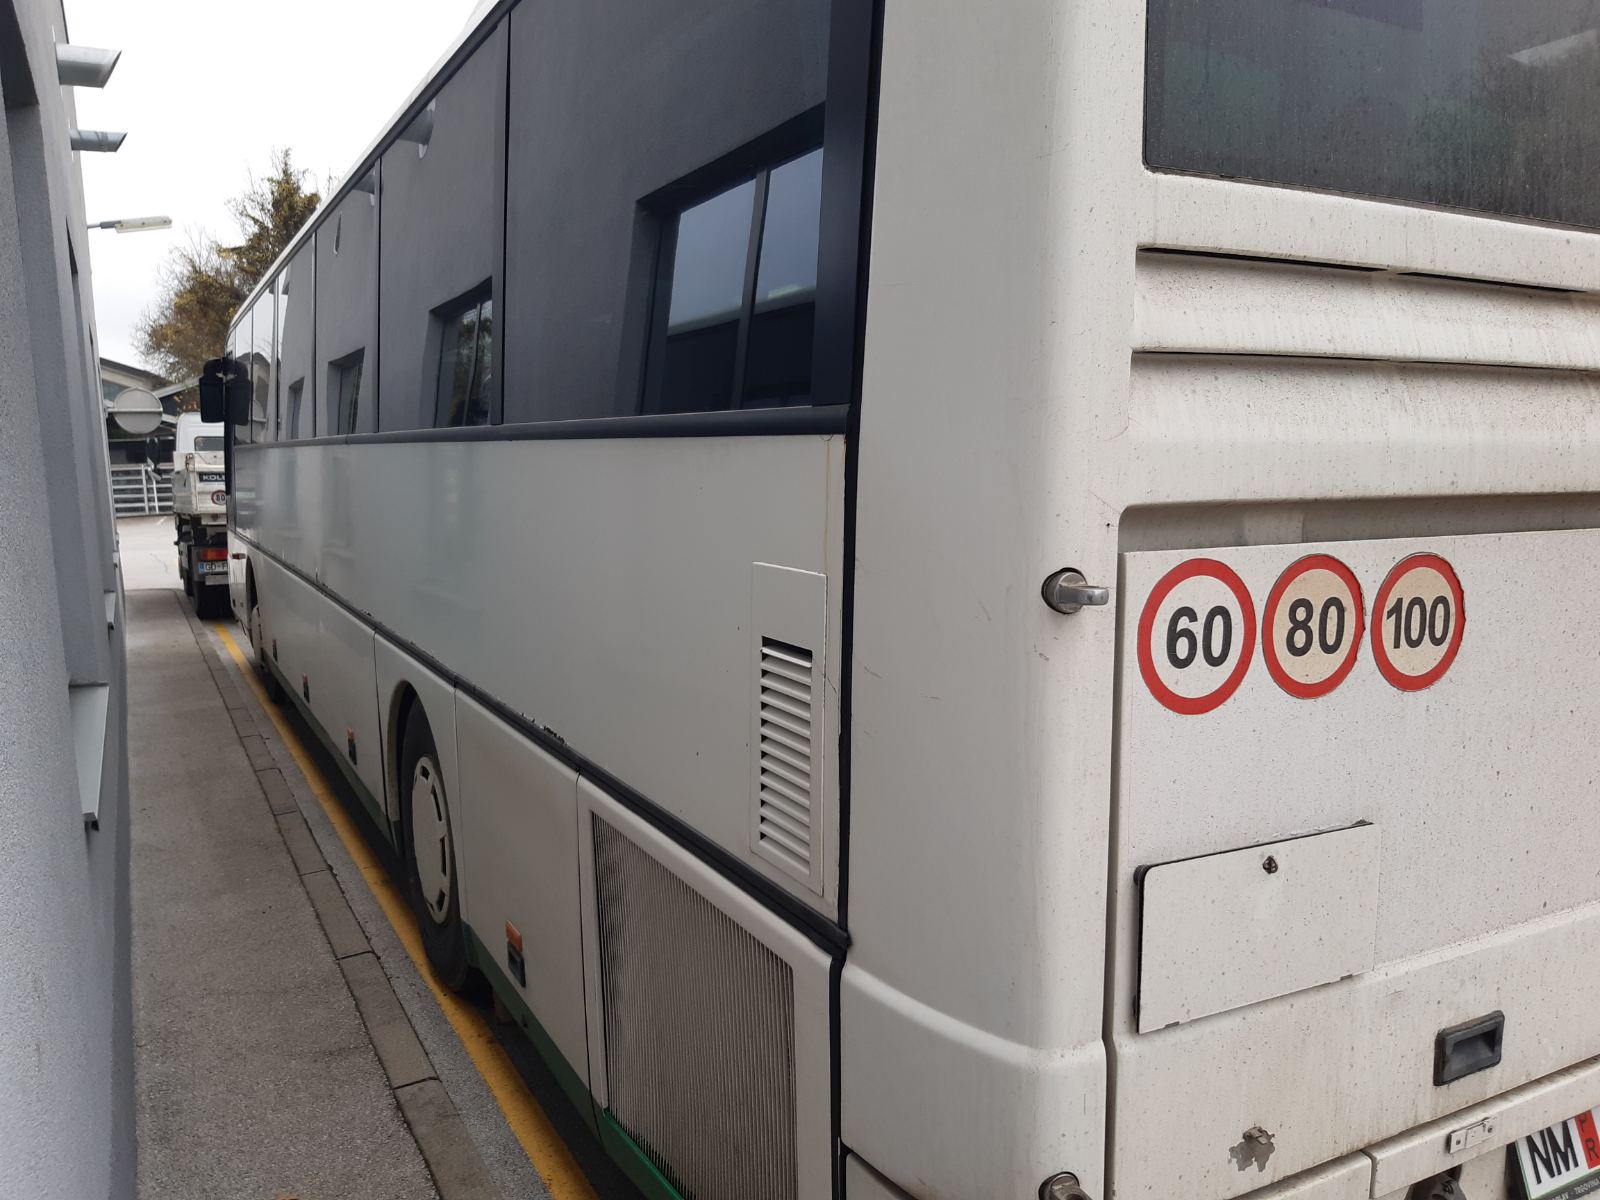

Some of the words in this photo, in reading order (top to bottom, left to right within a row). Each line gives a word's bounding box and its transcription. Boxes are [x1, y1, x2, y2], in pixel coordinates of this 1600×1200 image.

[1166, 605, 1233, 669] 60
[1286, 596, 1345, 657] 80
[1386, 595, 1451, 649] 100
[1525, 1120, 1579, 1185] NM
